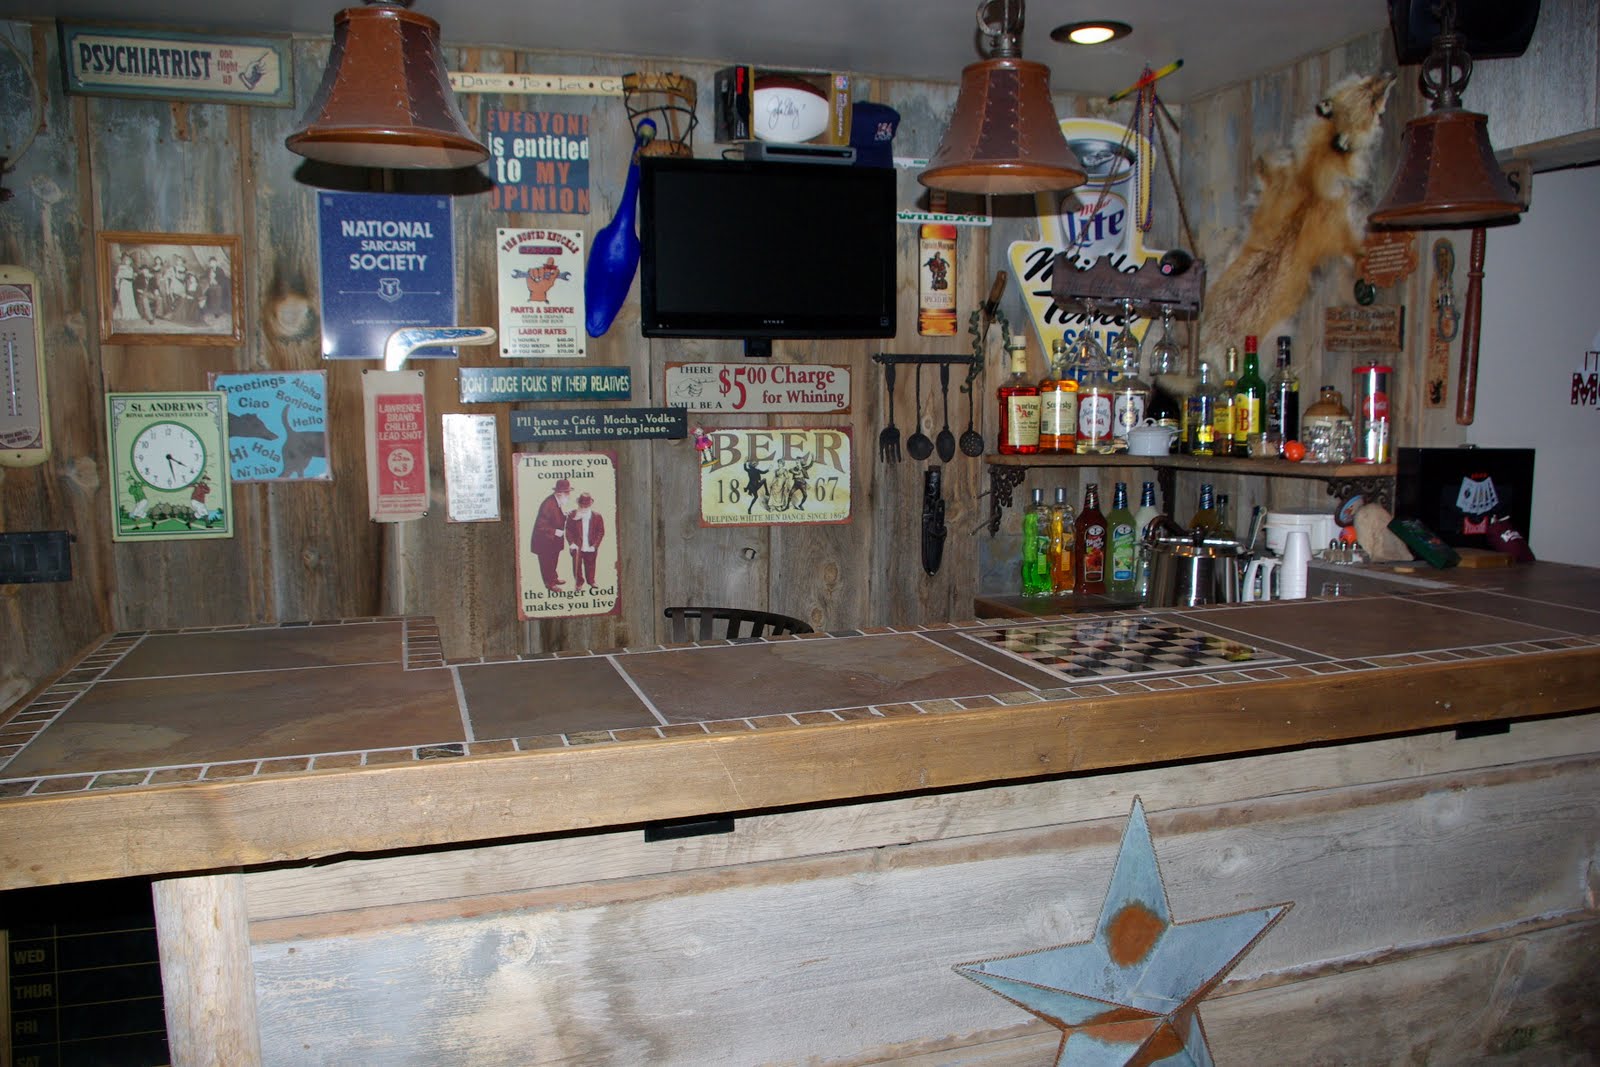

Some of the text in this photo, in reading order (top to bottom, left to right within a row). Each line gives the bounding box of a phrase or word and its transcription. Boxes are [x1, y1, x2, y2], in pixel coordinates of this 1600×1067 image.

[79, 43, 212, 79] PSYCHIATRIST
[461, 74, 504, 88] Dare
[488, 132, 589, 160] is entitled
[496, 158, 571, 185] to MY
[897, 213, 987, 223] WILDCATS
[341, 220, 433, 238] NATIONAL
[1066, 208, 1125, 248] Lite
[361, 240, 416, 252] SARCASM
[349, 254, 428, 271] SOCIETY
[216, 376, 286, 394] Greetings
[490, 375, 518, 393] JUDGE
[521, 375, 547, 392] FOLKS
[551, 375, 562, 392] BY
[565, 375, 587, 392] THEIR
[591, 375, 630, 392] RELATIVES
[679, 366, 713, 374] THERE
[770, 365, 836, 390] Charge
[291, 378, 321, 400] Aloha
[238, 397, 270, 408] Ciao
[275, 390, 322, 413] Bonjour
[670, 401, 723, 409] WILL BE A
[762, 390, 845, 407] for Whining
[150, 402, 204, 412] ANDREWS
[379, 404, 422, 413] LAWRENCE
[292, 416, 323, 427] Hello
[387, 413, 415, 422] BRAND
[534, 415, 559, 426] have
[563, 418, 569, 426] a
[571, 415, 596, 426] Café
[603, 415, 637, 425] Mocha
[645, 414, 675, 424] Vodka
[384, 422, 418, 431] CHILLED
[533, 426, 566, 437] Xanax
[575, 426, 601, 435] Latte
[616, 427, 632, 437] go,
[634, 424, 669, 435] please.
[379, 431, 422, 441] LEAD SHOT
[230, 446, 248, 463] Hi
[252, 442, 281, 463] Hola
[709, 432, 846, 474] BEER
[523, 457, 608, 468] The more you
[537, 468, 595, 480] complain
[717, 476, 839, 504] 18 67
[706, 514, 738, 523] HELPING
[739, 513, 762, 521] WHITE
[764, 513, 780, 521] MEN
[782, 513, 805, 521] DANCE
[807, 512, 828, 520] SINCE
[524, 586, 614, 600] the longer God
[525, 598, 614, 612] makes you live
[14, 949, 45, 965] WED
[14, 983, 52, 1000] THUR
[15, 1019, 37, 1035] FRI
